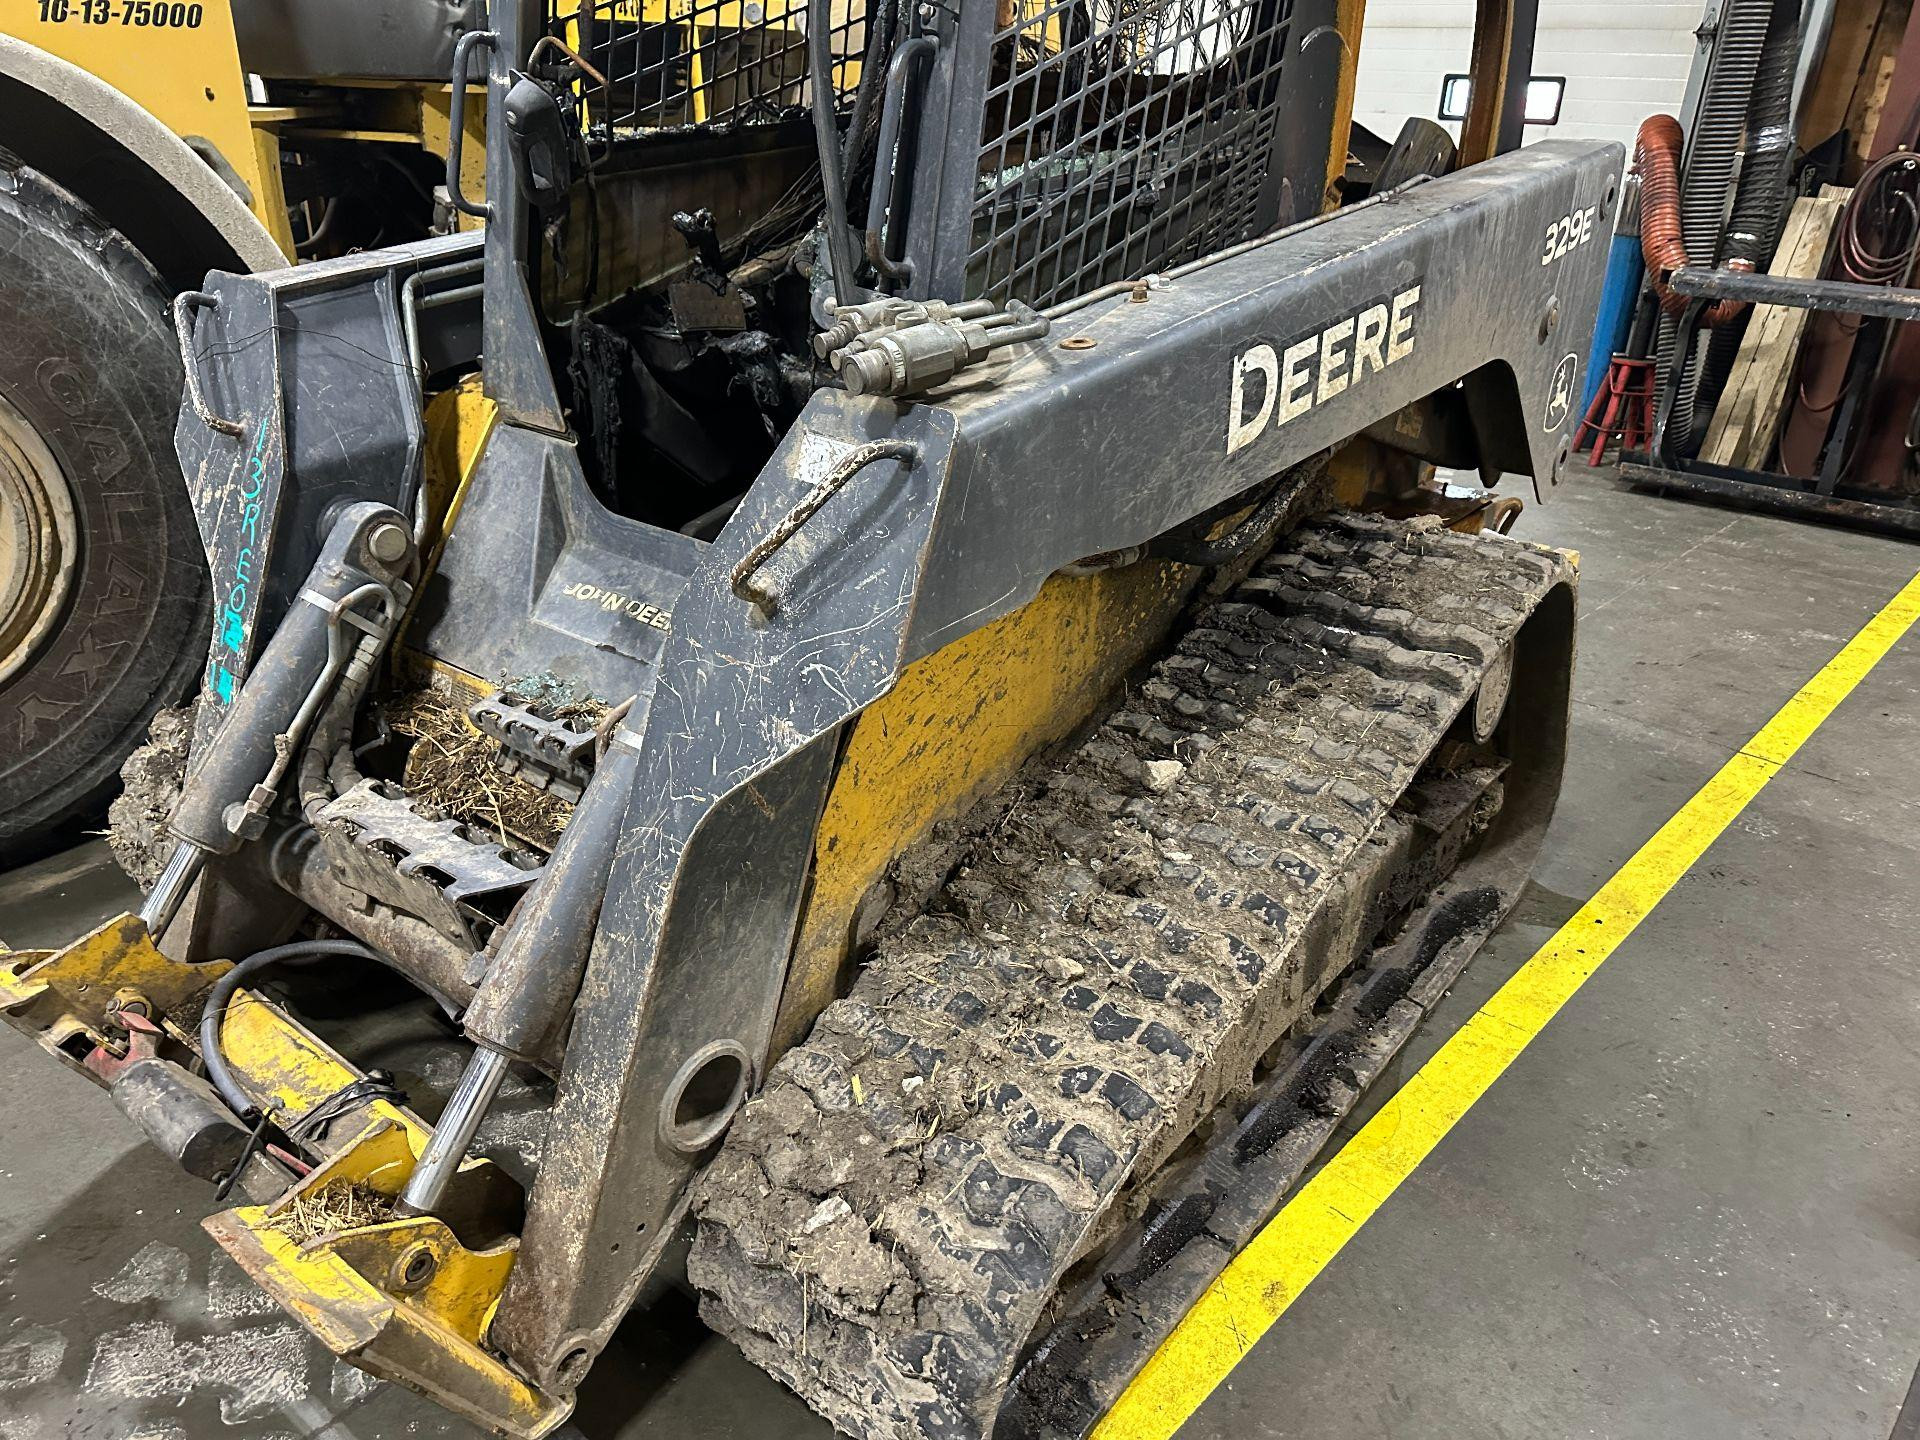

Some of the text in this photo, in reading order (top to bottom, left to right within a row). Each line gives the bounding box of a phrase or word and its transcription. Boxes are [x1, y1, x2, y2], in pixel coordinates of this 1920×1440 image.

[1541, 206, 1596, 266] 329E
[1226, 285, 1421, 455] DEERE
[563, 582, 672, 630] JOHN DEE
